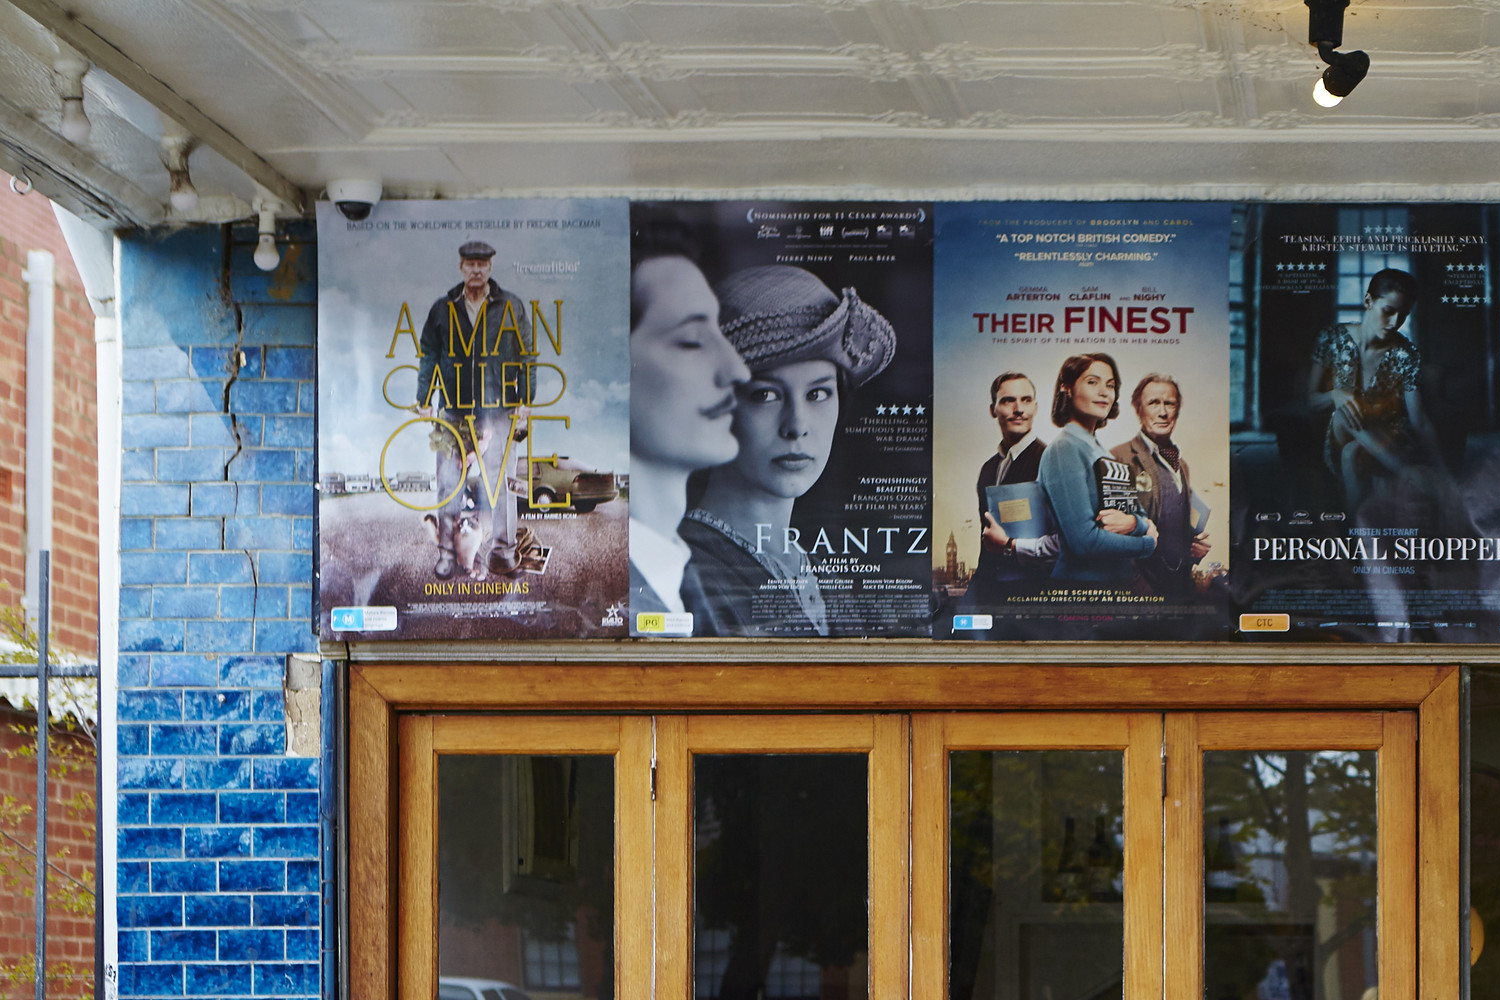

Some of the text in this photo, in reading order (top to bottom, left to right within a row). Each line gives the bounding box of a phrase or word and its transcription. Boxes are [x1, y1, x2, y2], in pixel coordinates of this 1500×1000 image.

[1011, 234, 1033, 243] TOP
[1036, 234, 1075, 243] NOTCH
[1078, 234, 1119, 243] BRITISH
[1333, 235, 1363, 243] EERIE
[1368, 235, 1388, 243] AND
[1392, 235, 1455, 244] PRICKLISHLY
[1006, 293, 1166, 301] ARTERTON CLAFLIN NIGHY
[972, 307, 1194, 334] THEIR FINEST
[386, 300, 563, 358] A MAN
[383, 362, 566, 409] CALLED
[380, 415, 570, 510] OVE
[1349, 528, 1418, 536] KRISTEN STEWART
[754, 523, 928, 555] FRANTZ
[1253, 537, 1387, 561] PERSONAL
[800, 564, 880, 574] FRANÇOIS OZON
[1353, 566, 1415, 575] ONLY IN CINEMAS
[425, 582, 529, 596] ONLY IN CINEMAS
[344, 615, 352, 624] M
[1256, 618, 1273, 628] CTC
